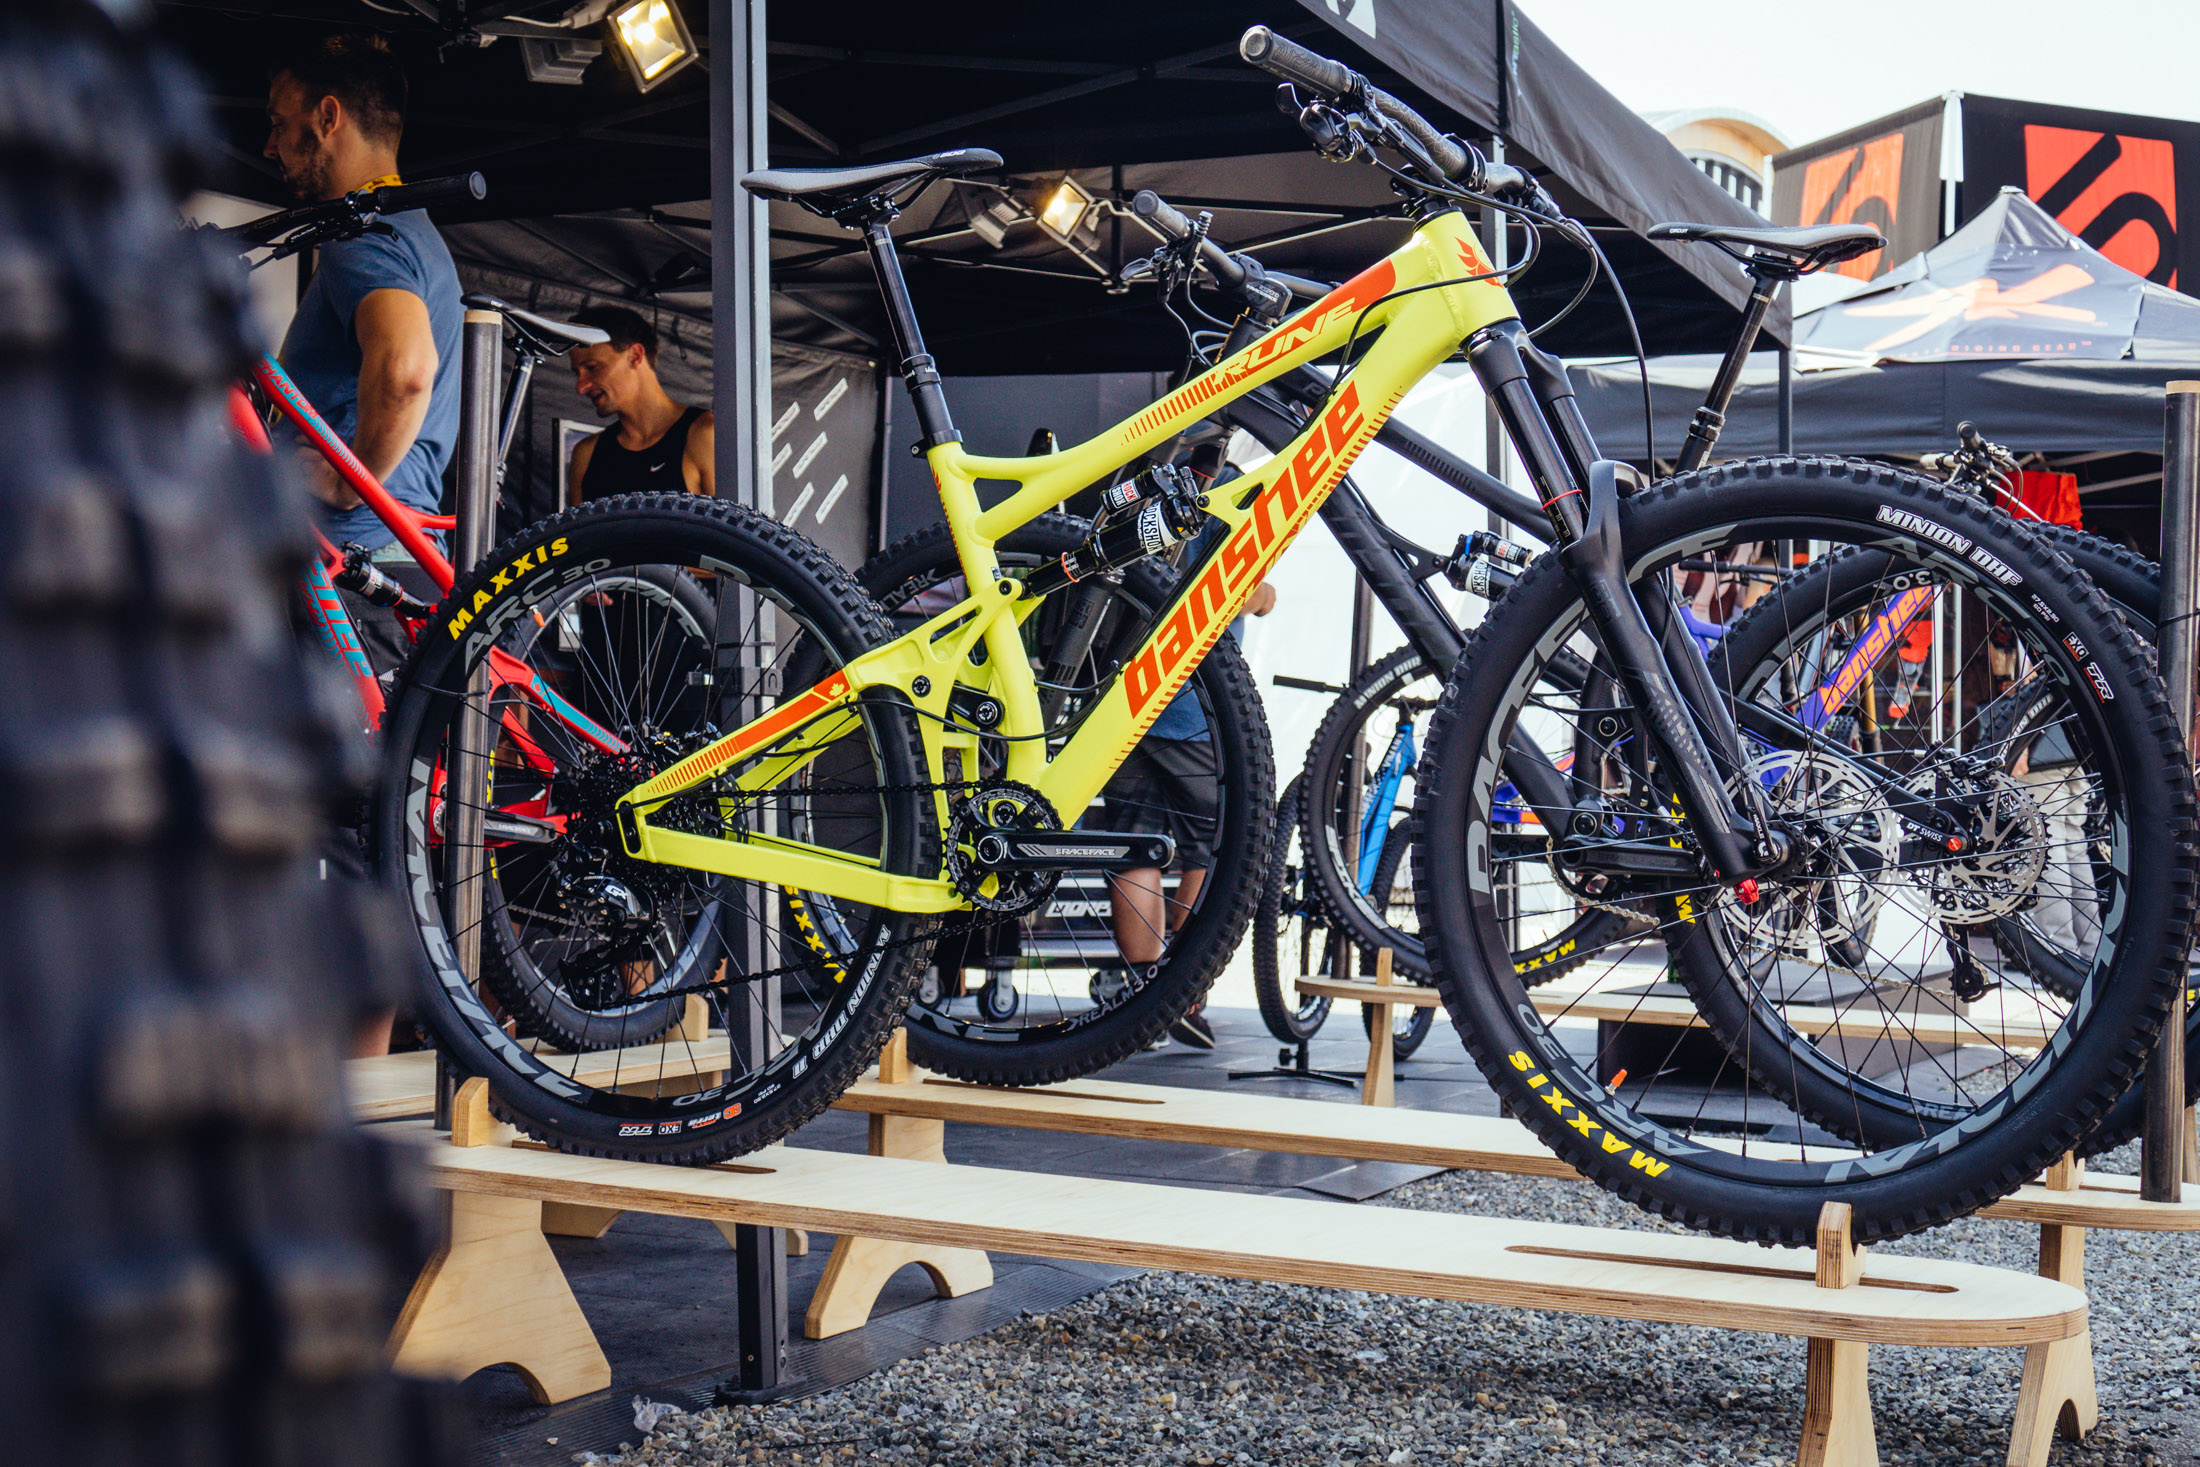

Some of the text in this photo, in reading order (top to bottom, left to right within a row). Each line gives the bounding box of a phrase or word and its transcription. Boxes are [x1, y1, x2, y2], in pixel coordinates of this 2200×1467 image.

[1215, 297, 1355, 381] RUNE
[1951, 345, 2021, 353] RIDING
[2032, 342, 2077, 352] GEAR
[1123, 482, 1138, 501] ROCK
[1124, 379, 1364, 720] banshee
[1876, 505, 2023, 587] MINION DHF
[448, 537, 569, 641] MAXXIS
[1863, 536, 2031, 623] ARC
[2018, 628, 2071, 686] 30
[465, 568, 557, 677] ARC
[562, 558, 612, 585] 30
[2065, 634, 2088, 659] EXO
[2087, 661, 2115, 700] TR
[1061, 847, 1117, 857] RACEFACE
[1905, 822, 1944, 842] DT SWISS
[812, 1009, 849, 1060] DHR
[618, 1125, 654, 1137] TR
[659, 1122, 682, 1135] EXO
[1508, 1050, 1671, 1178] MAXXIS
[1550, 1064, 1713, 1157] ARC
